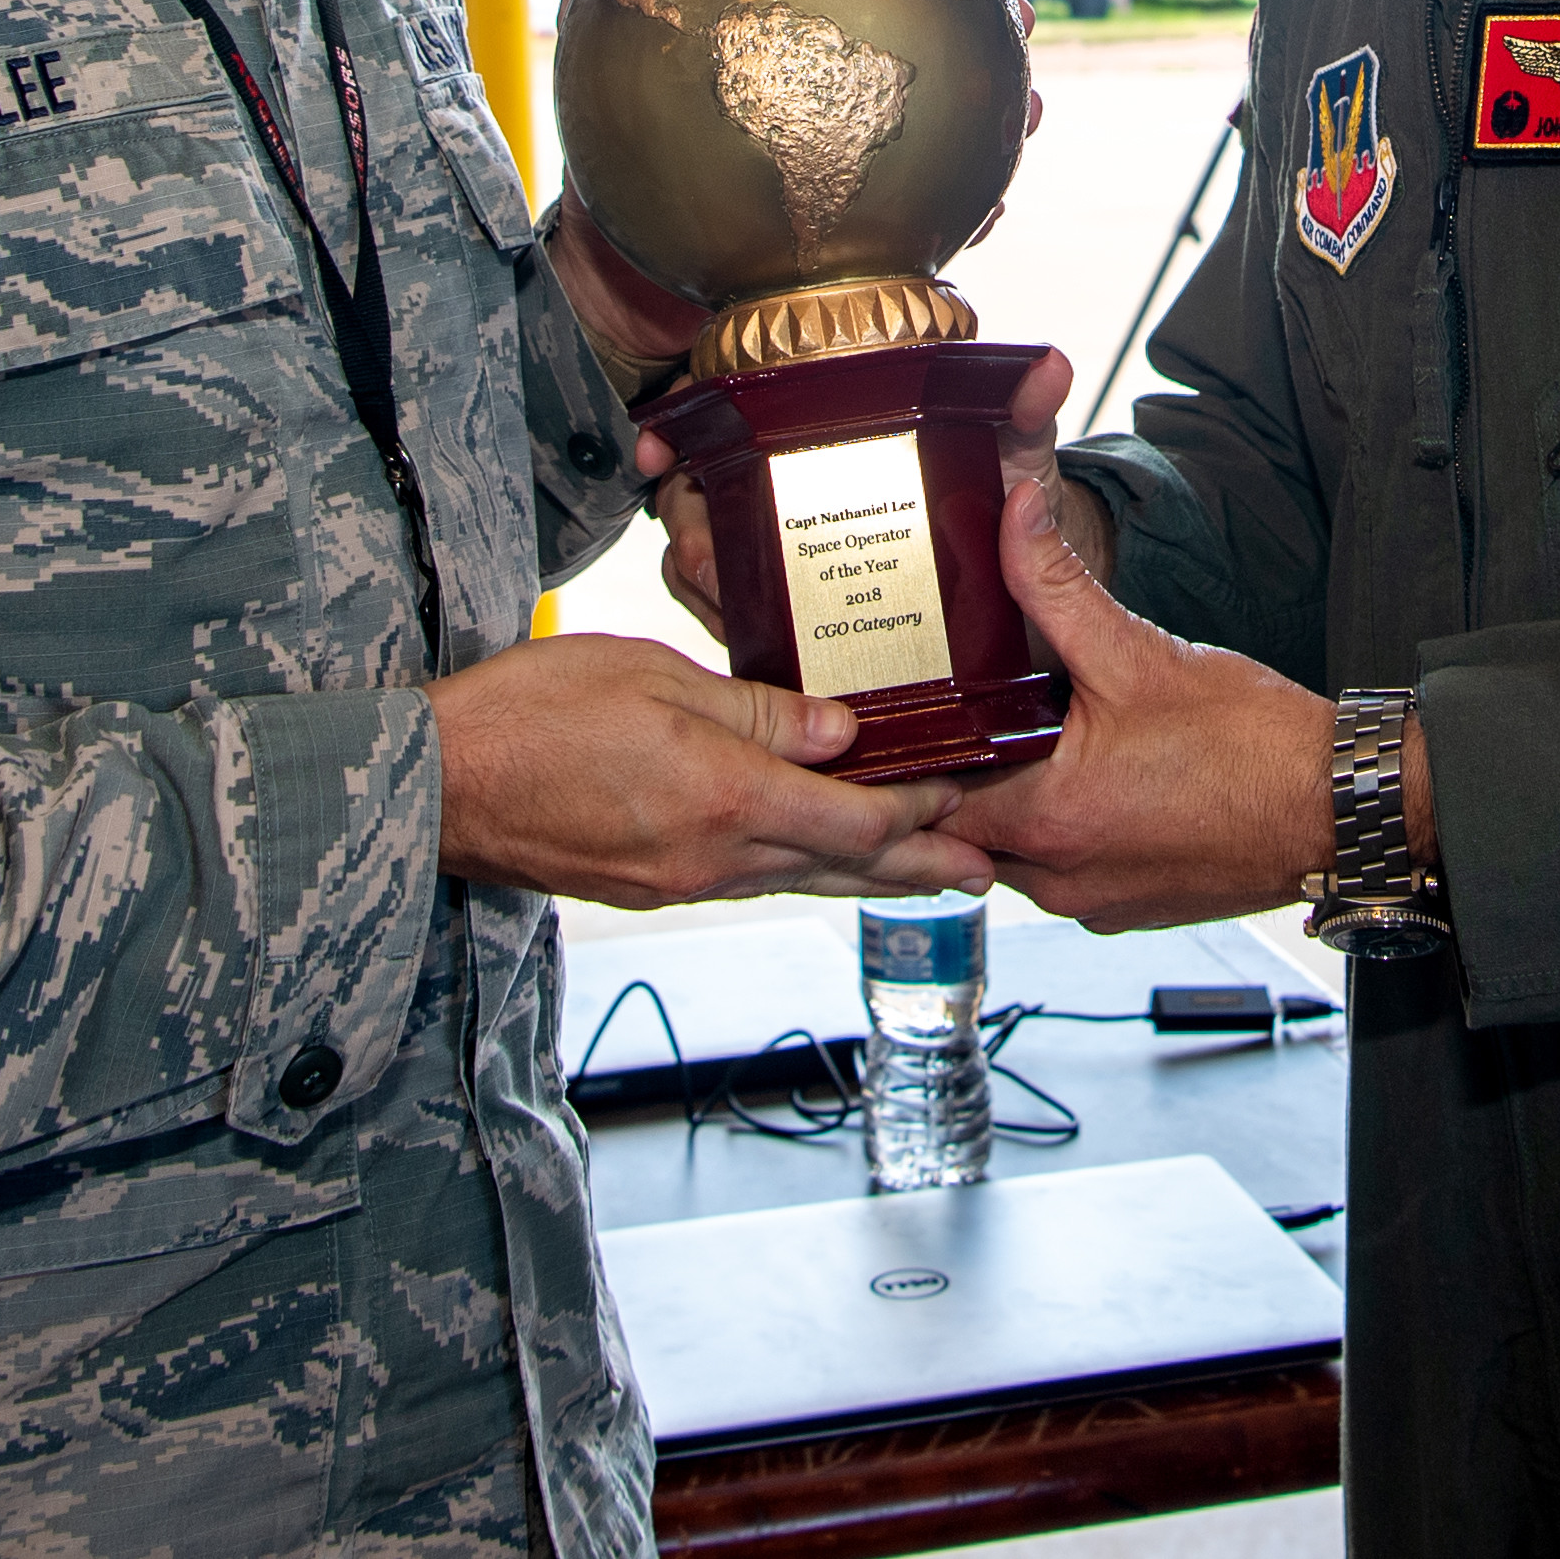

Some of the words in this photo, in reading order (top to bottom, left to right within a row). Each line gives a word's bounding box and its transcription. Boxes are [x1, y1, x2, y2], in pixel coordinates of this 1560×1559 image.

[1302, 214, 1314, 241] AIR
[1314, 228, 1346, 264] COMBAT
[1347, 178, 1387, 248] COMMAND
[785, 515, 818, 530] Capt
[820, 503, 888, 525] Nathaniel
[892, 499, 916, 512] Lee
[798, 540, 842, 558] Space
[845, 527, 912, 550] Operator
[820, 566, 835, 582] of
[838, 563, 862, 579] the
[864, 557, 899, 574] Year
[845, 587, 883, 606] 2018
[814, 621, 849, 640] CGO
[853, 611, 923, 633] Category
